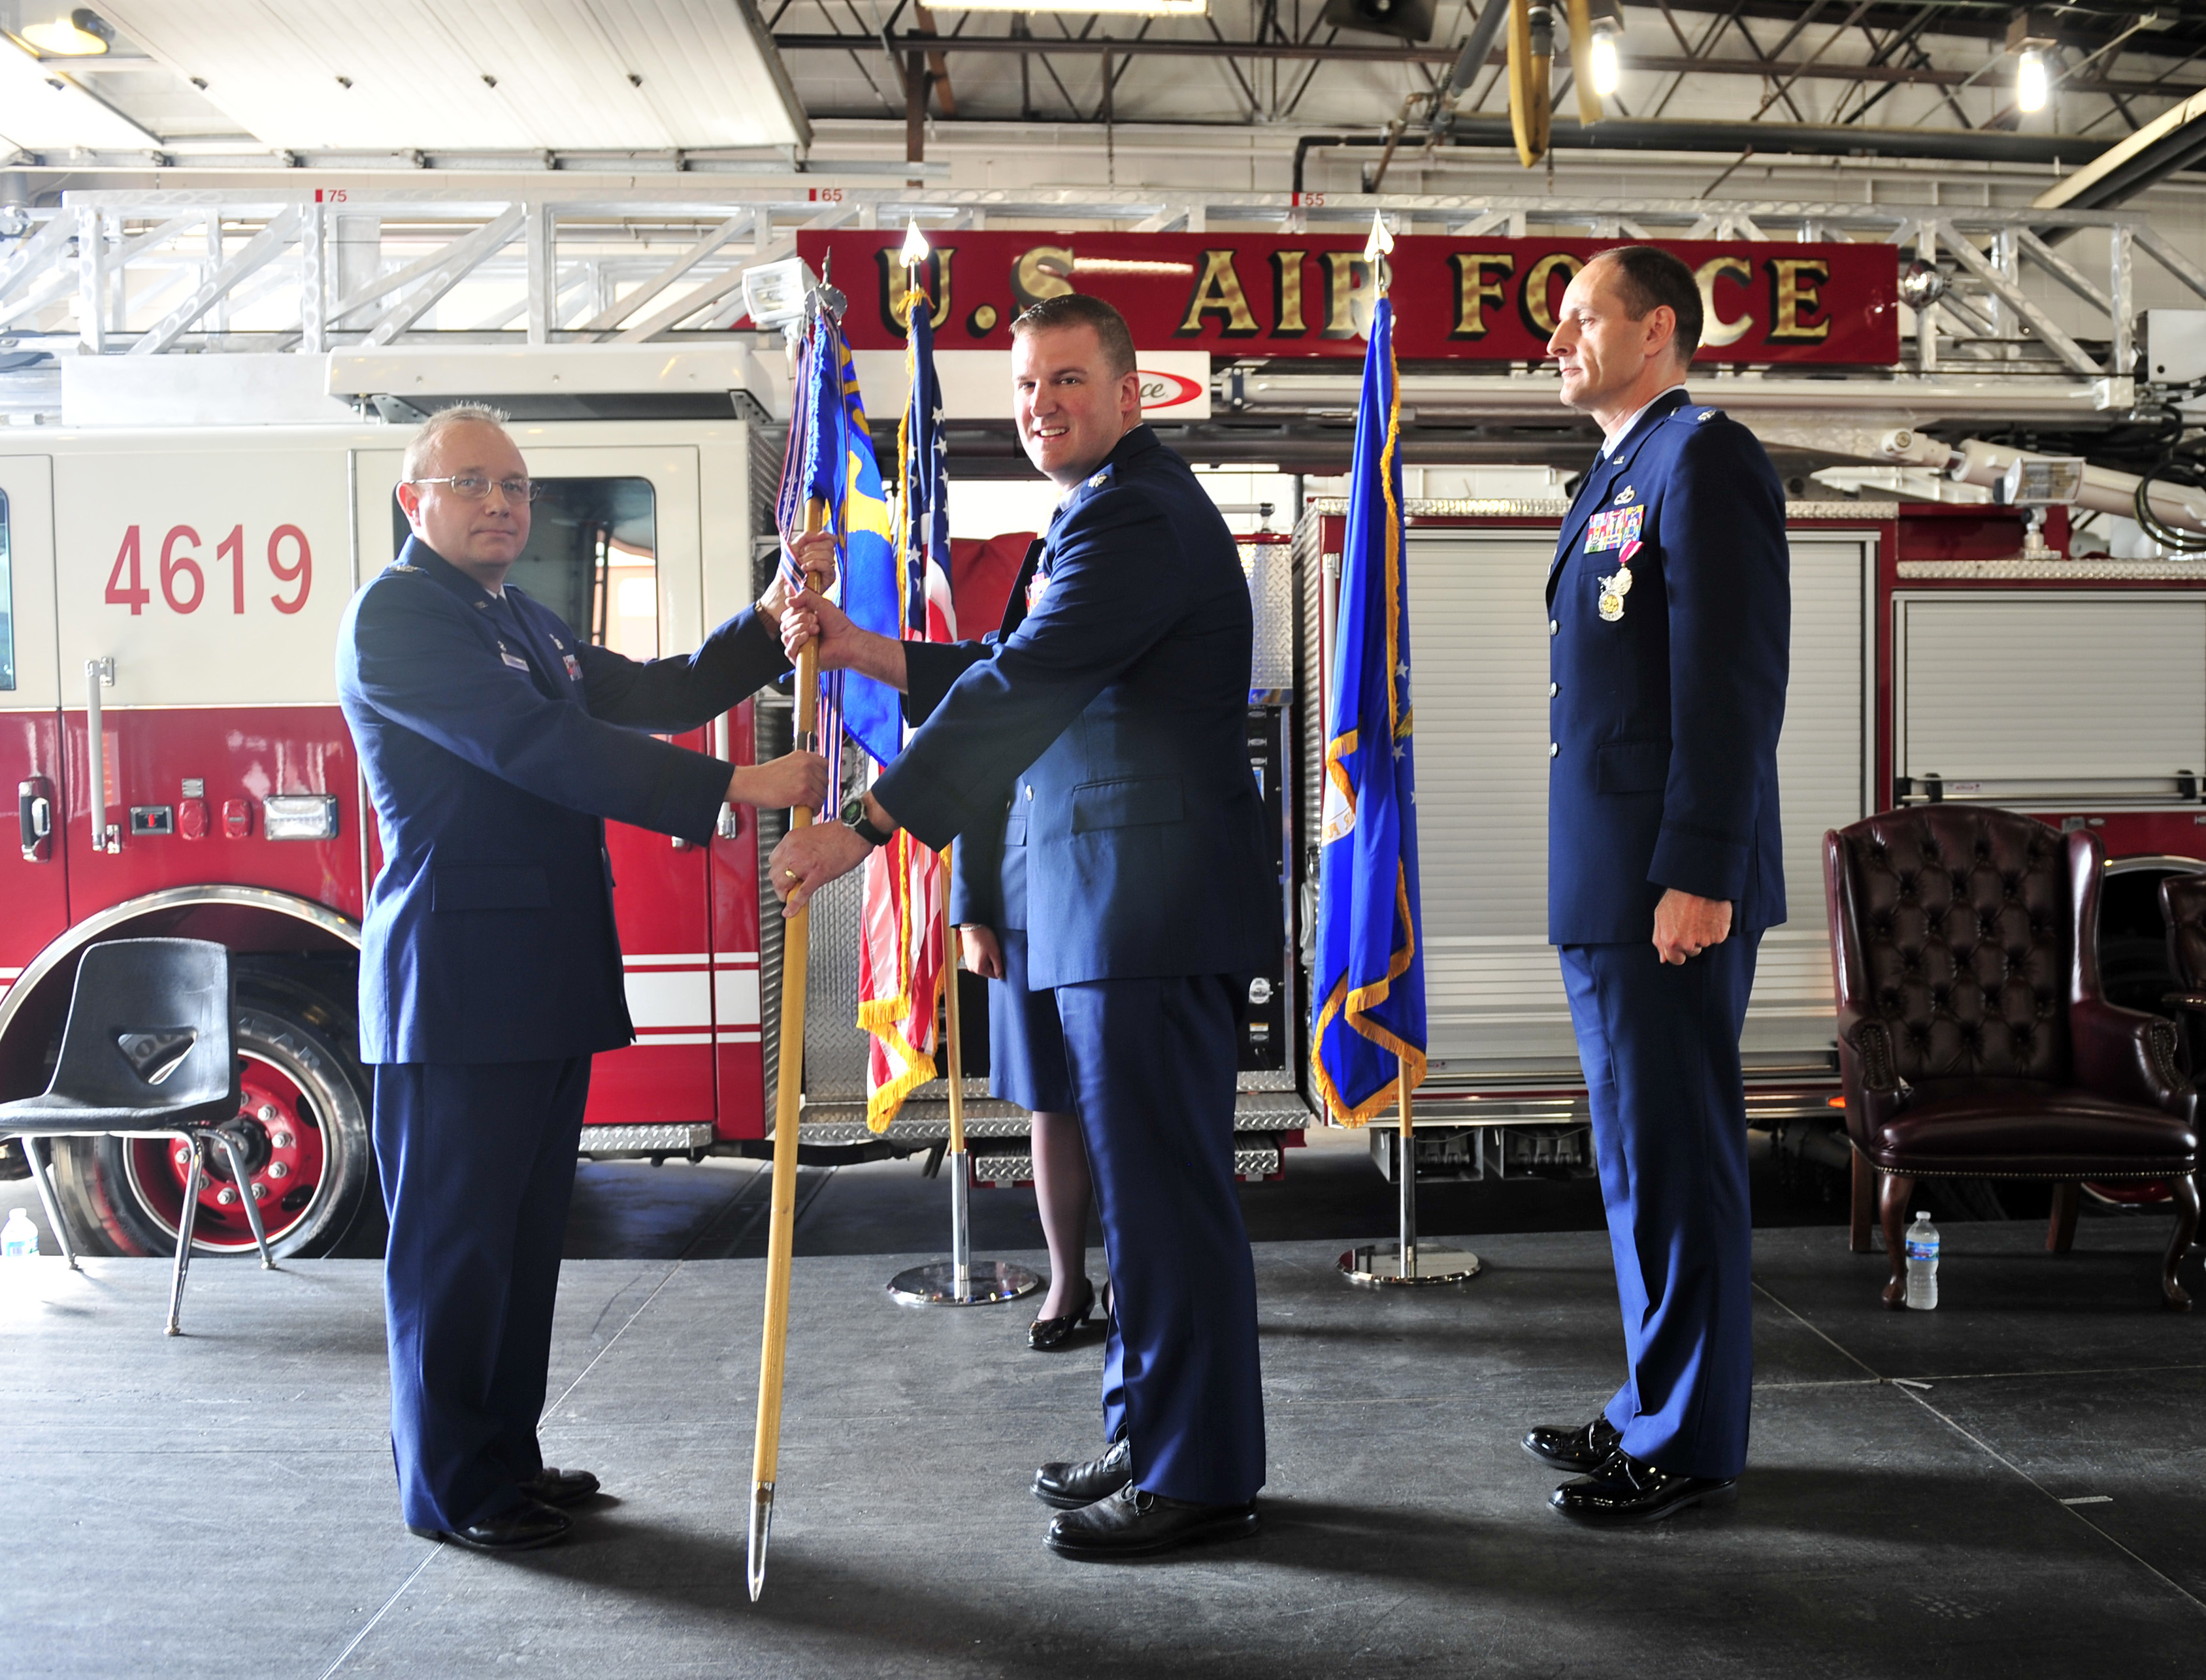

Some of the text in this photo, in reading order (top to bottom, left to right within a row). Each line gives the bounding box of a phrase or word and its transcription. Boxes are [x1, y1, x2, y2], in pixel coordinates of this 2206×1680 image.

[328, 189, 347, 203] 75
[822, 188, 842, 202] 65
[1306, 193, 1325, 206] 55
[1171, 250, 1394, 340] AIR
[1445, 252, 1832, 346] FOCE
[105, 523, 312, 616] 4619
